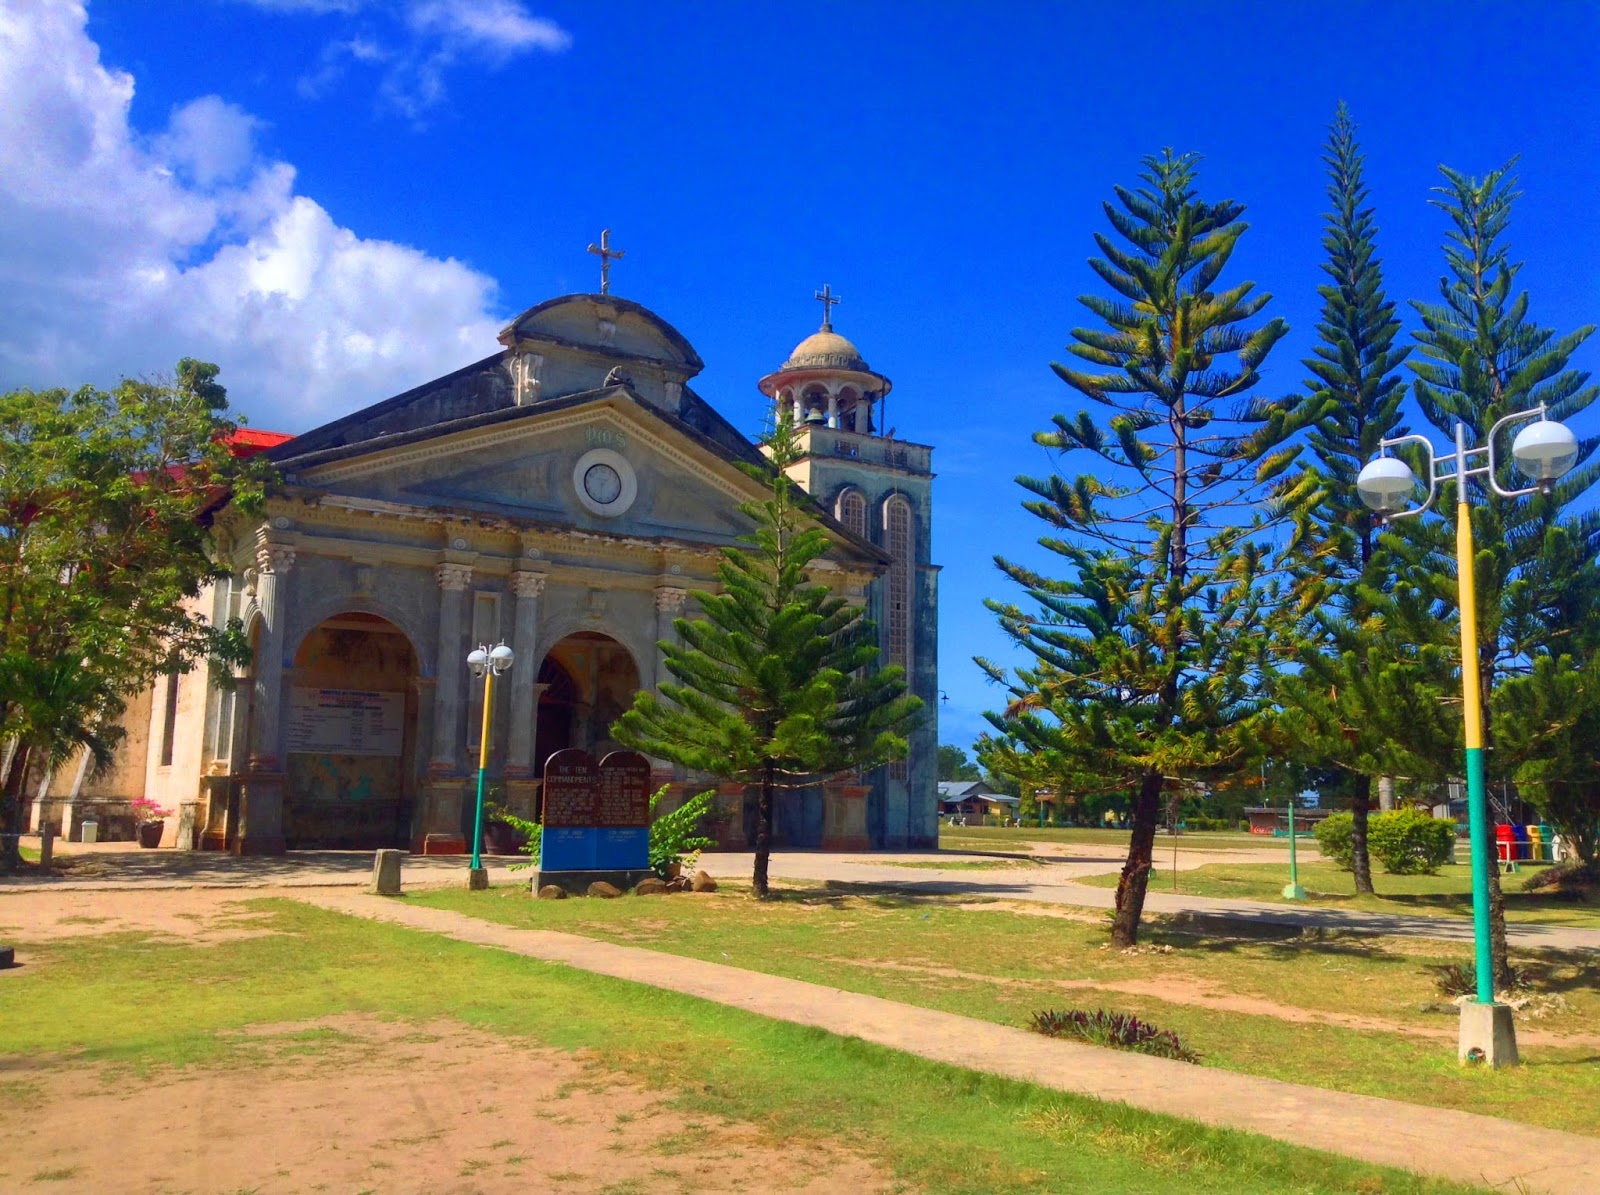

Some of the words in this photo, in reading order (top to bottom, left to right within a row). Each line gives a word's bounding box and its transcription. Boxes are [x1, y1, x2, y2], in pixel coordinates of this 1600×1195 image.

[559, 765, 571, 773] THE
[575, 765, 587, 774] TEN
[547, 775, 597, 784] COMMANDMENTS
